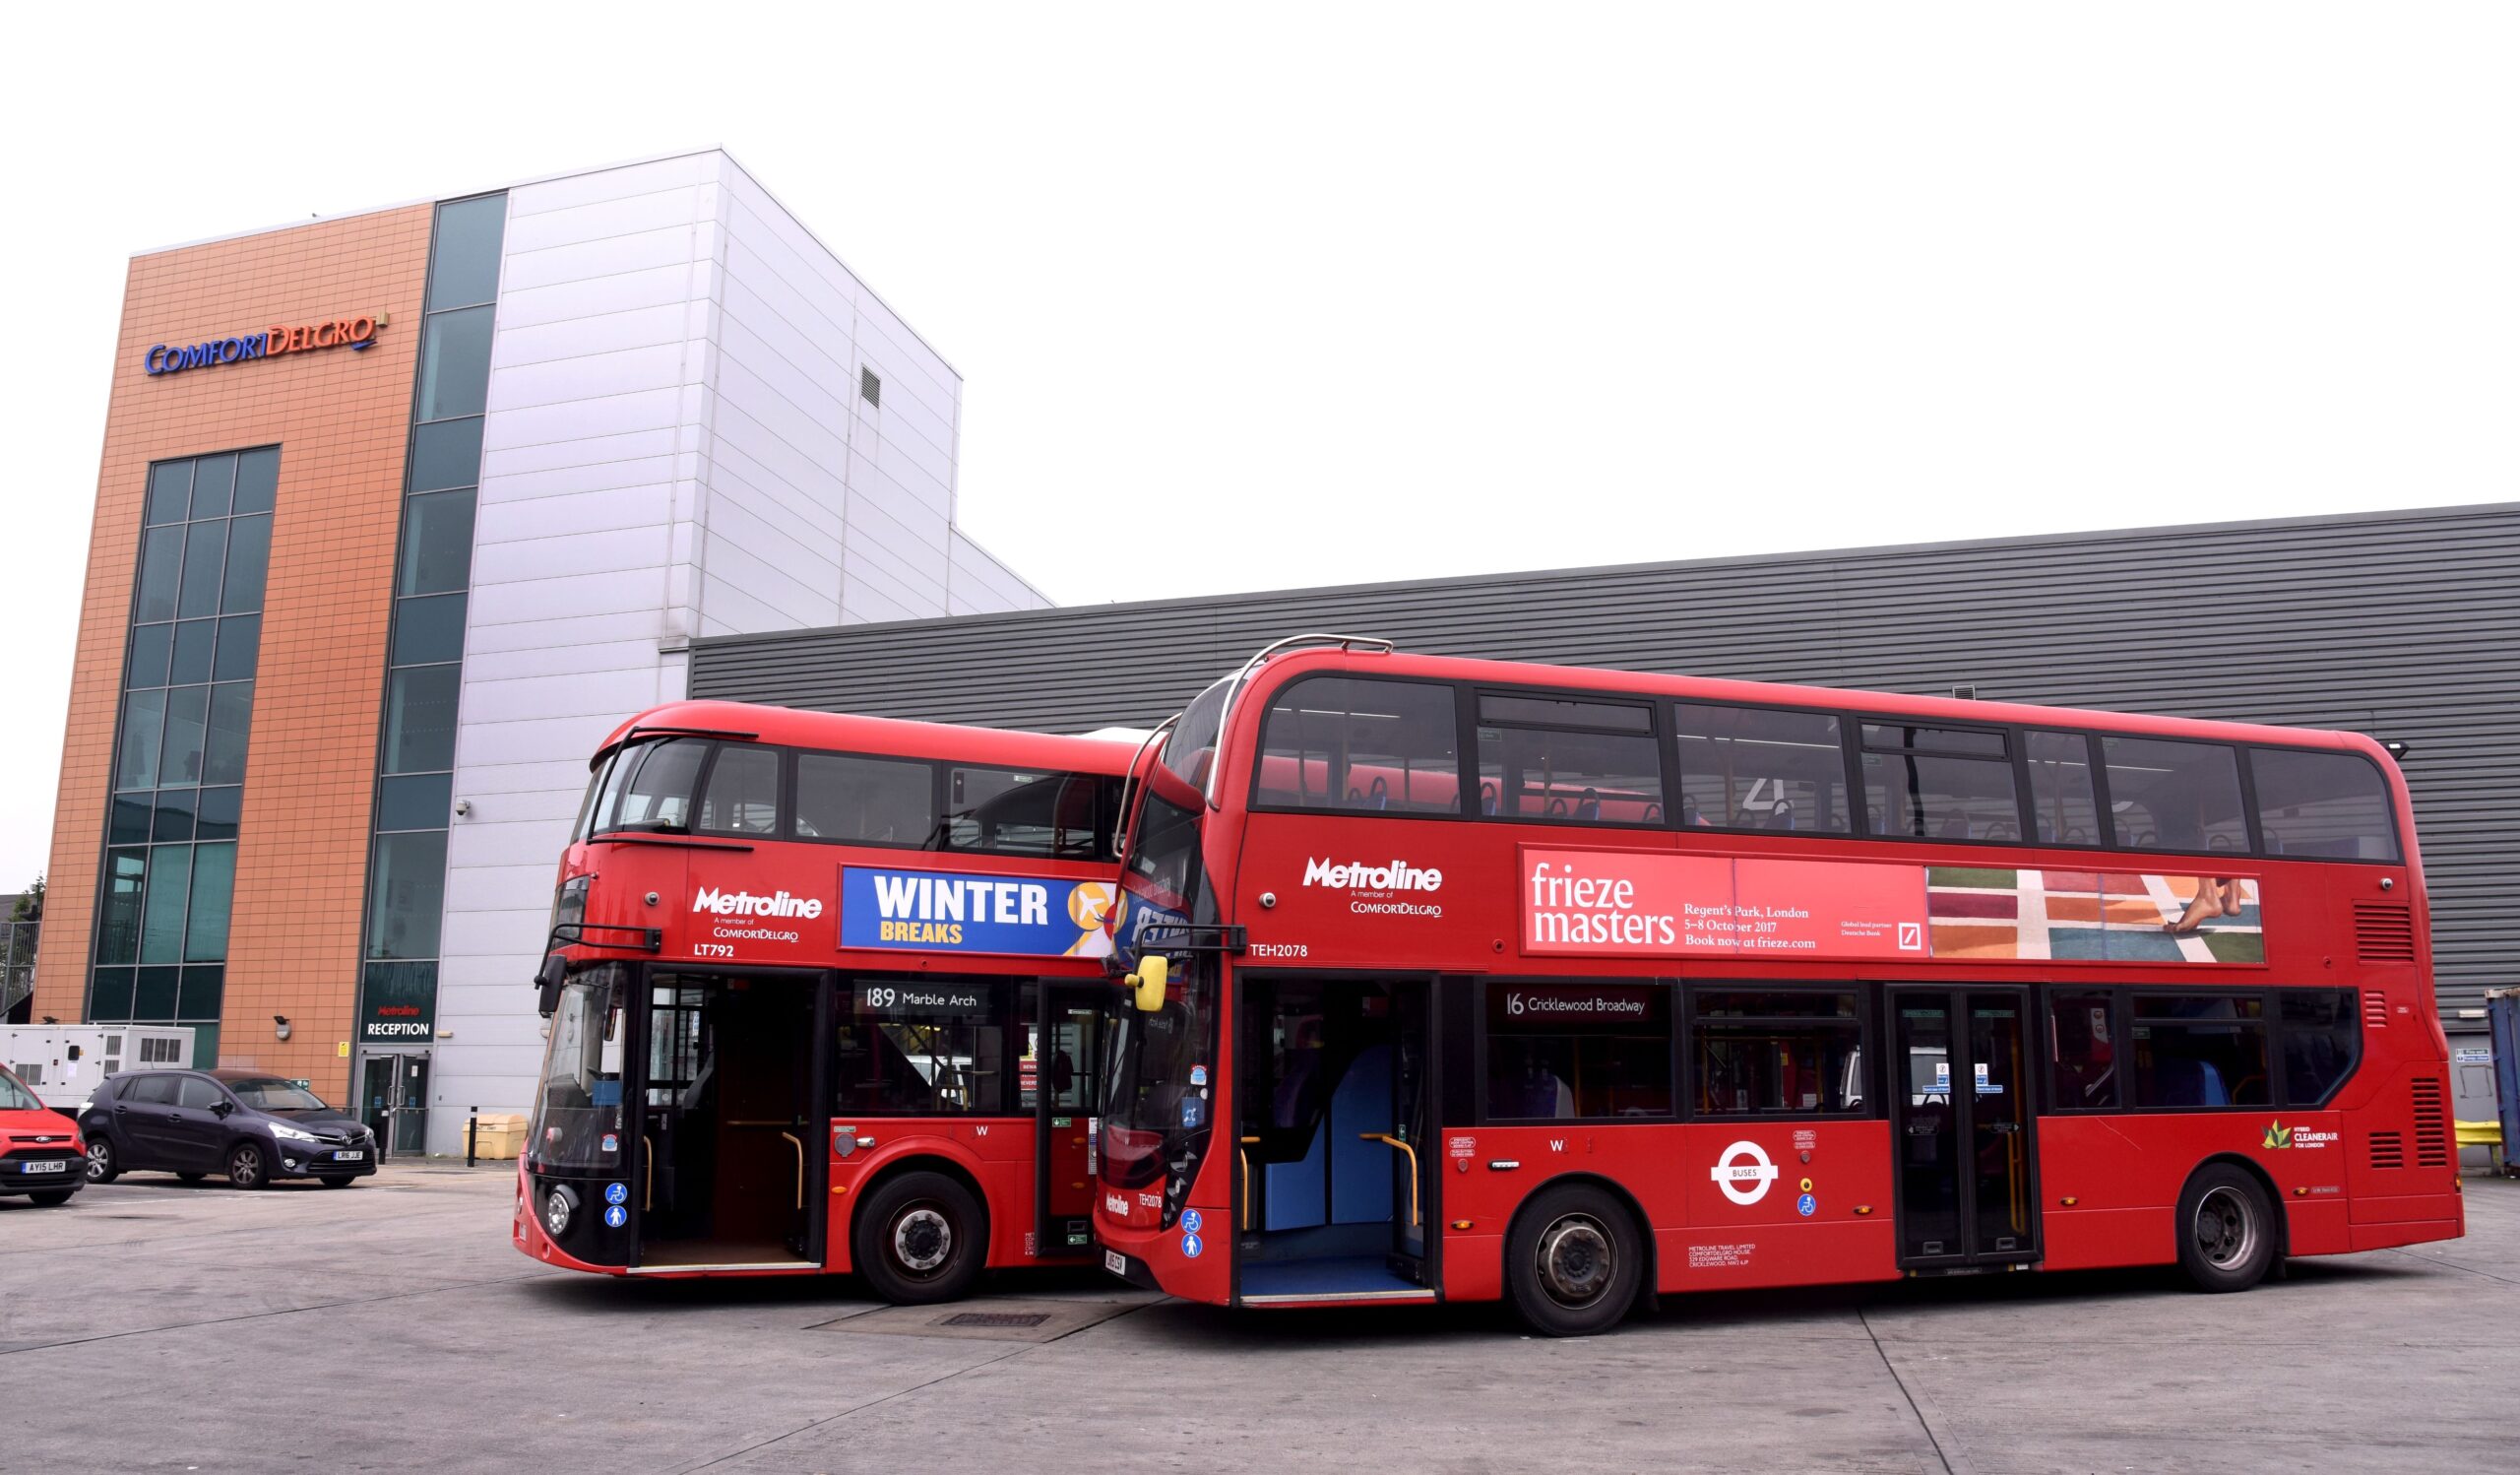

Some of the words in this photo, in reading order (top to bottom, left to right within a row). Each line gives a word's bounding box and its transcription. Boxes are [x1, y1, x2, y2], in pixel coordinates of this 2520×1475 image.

[1302, 856, 1443, 892] Metroline
[1532, 863, 1634, 909] frieze
[692, 886, 823, 920] Metroline
[873, 875, 1048, 926] WINTER
[1734, 906, 1764, 919] Park,
[1766, 907, 1809, 918] London
[880, 921, 963, 944] BREAKS
[1534, 909, 1675, 944] masters
[1706, 920, 1752, 932] October
[1754, 922, 1777, 932] 2017
[1685, 933, 1715, 945] Book
[1718, 937, 1740, 946] now
[1743, 938, 1755, 947] at
[1757, 936, 1816, 948] frieze.com
[694, 943, 734, 957] LT792
[1250, 944, 1308, 957] TEH2078
[866, 988, 896, 1007] 189
[903, 993, 945, 1005] Marble
[949, 994, 976, 1006] Arch
[1507, 993, 1524, 1015] 16
[1528, 997, 1593, 1011] Cricklewood
[1596, 997, 1645, 1015] Broadway
[367, 1023, 429, 1036] RECEPTION
[976, 1126, 988, 1136] W
[1550, 1139, 1564, 1152] W
[30, 1162, 47, 1172] AY15
[48, 1161, 64, 1171] LHR
[1732, 1169, 1757, 1178] BUSES
[1106, 1192, 1129, 1217] Metroline
